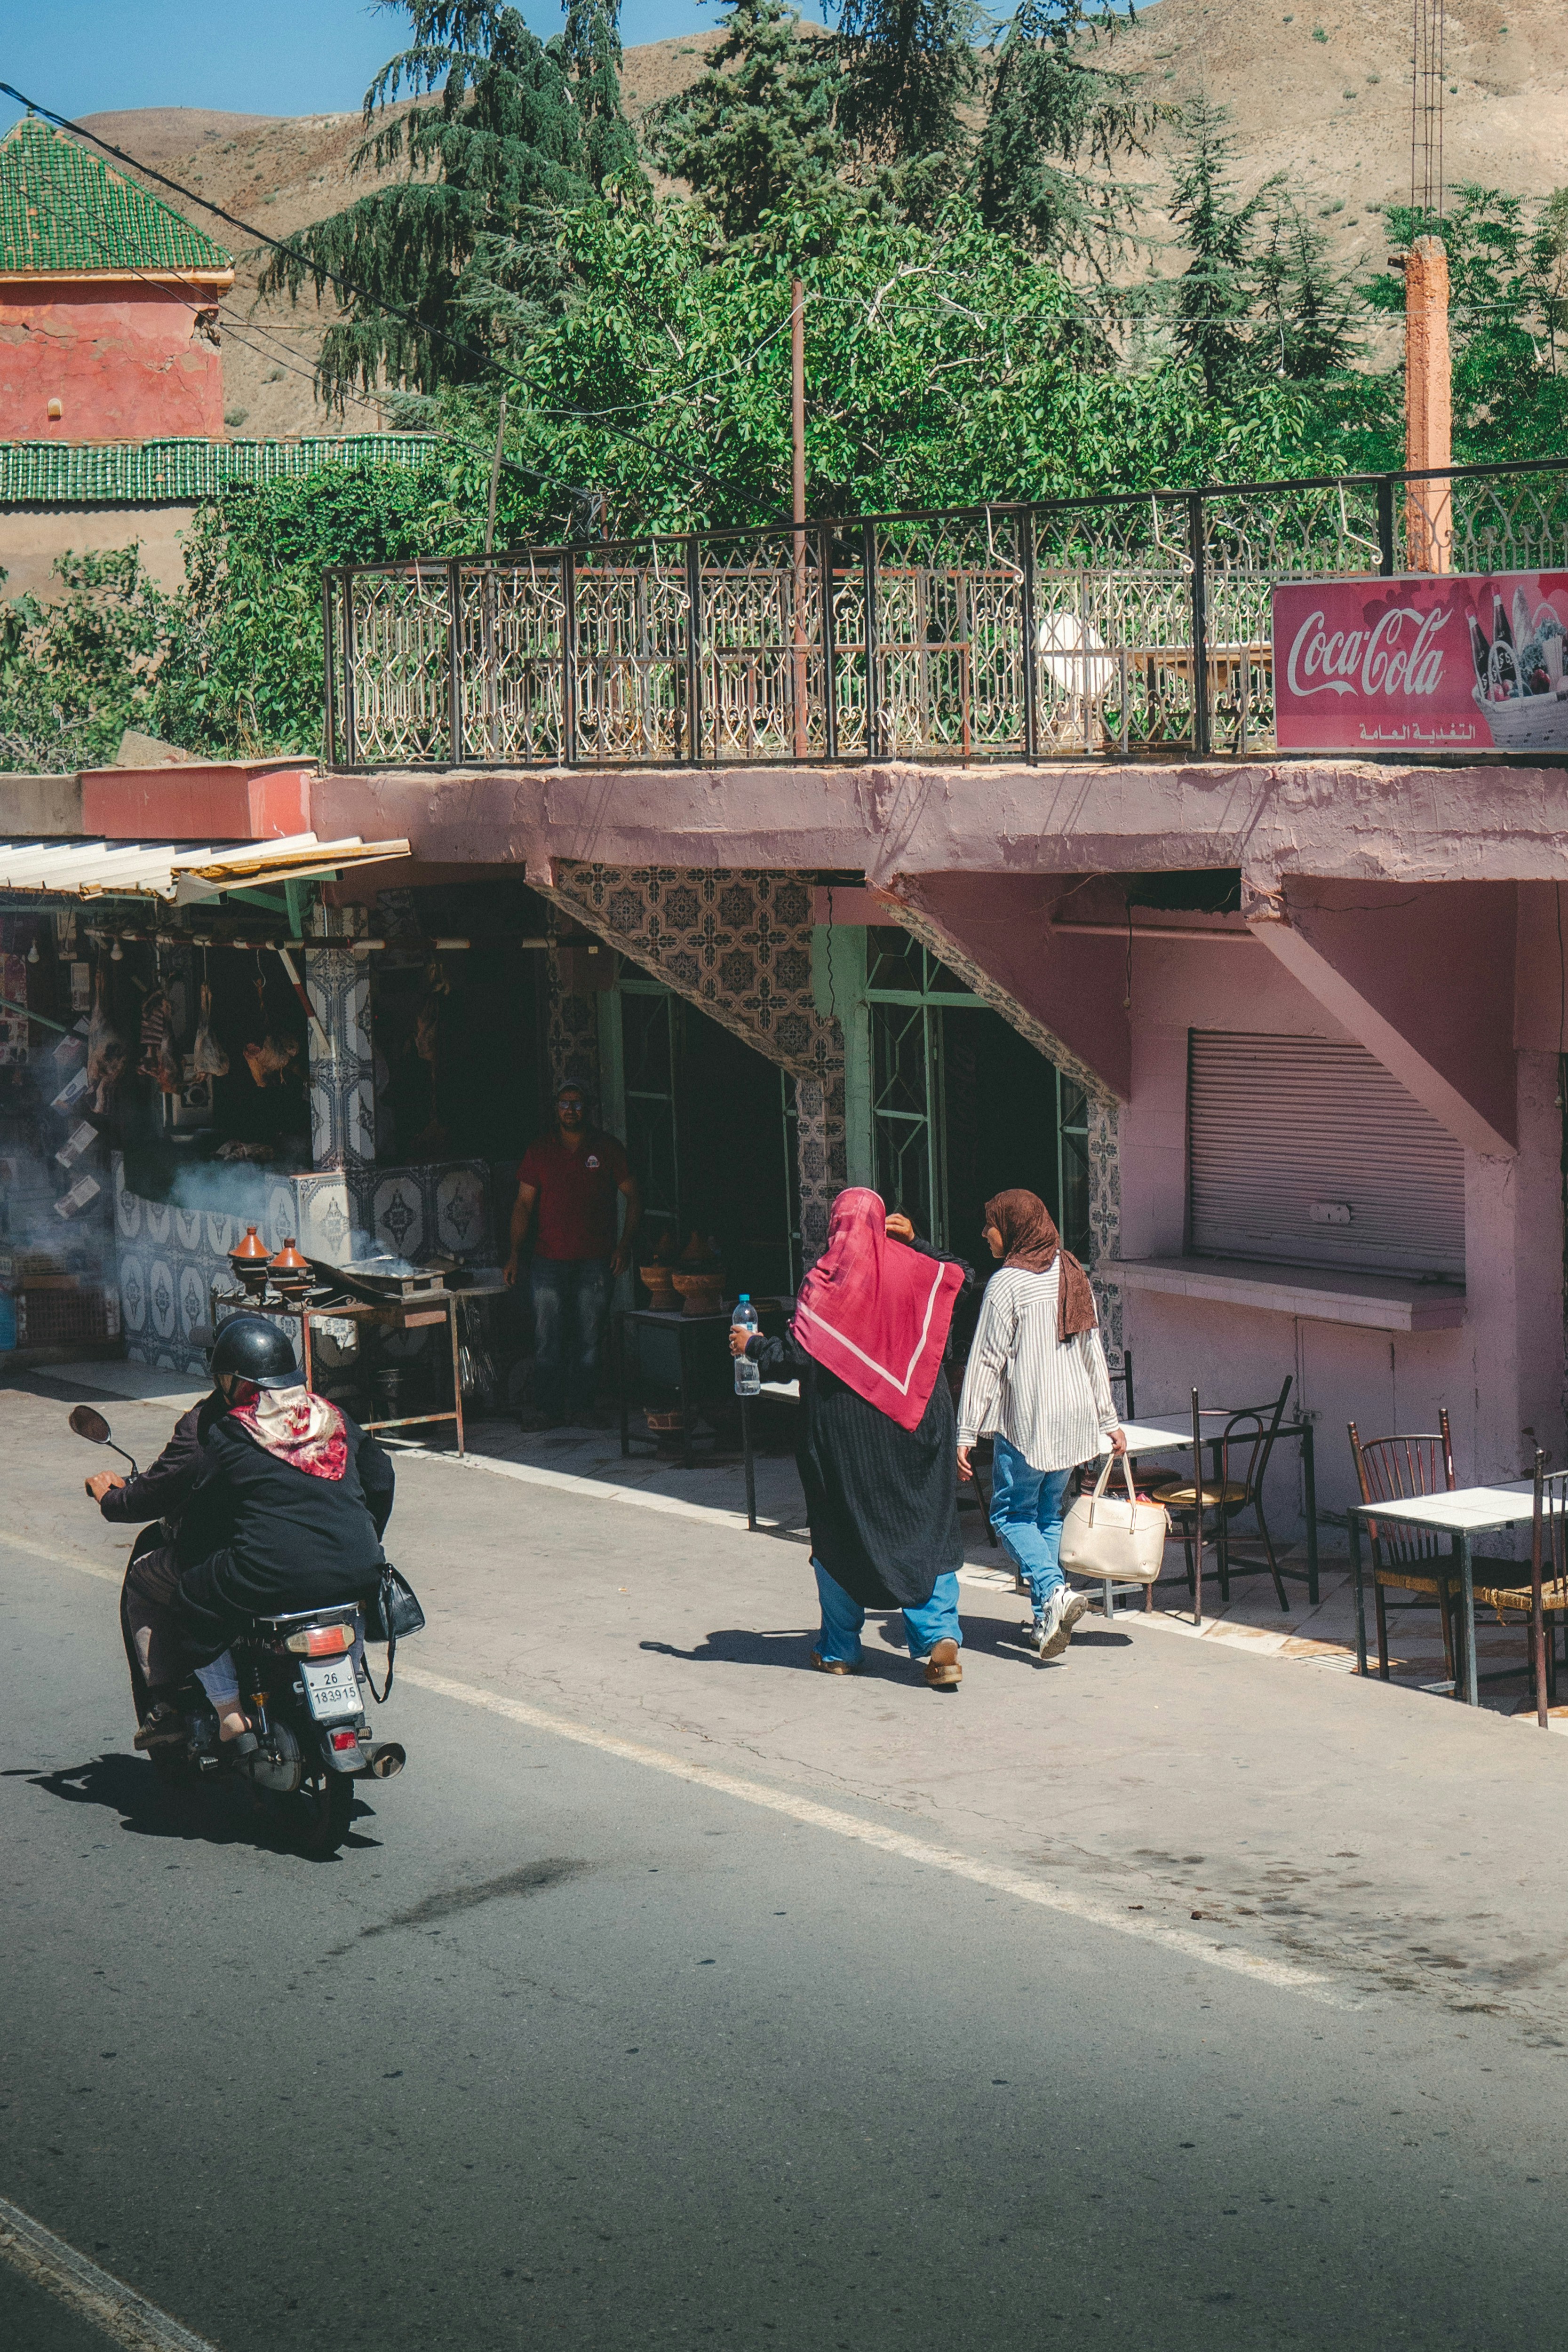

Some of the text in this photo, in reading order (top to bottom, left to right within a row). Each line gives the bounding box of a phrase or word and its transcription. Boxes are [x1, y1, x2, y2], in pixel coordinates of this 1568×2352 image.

[1287, 608, 1454, 697] Coca-Cola
[1359, 723, 1410, 740] العامة
[324, 1673, 337, 1685] 26
[315, 1686, 356, 1704] 183915
